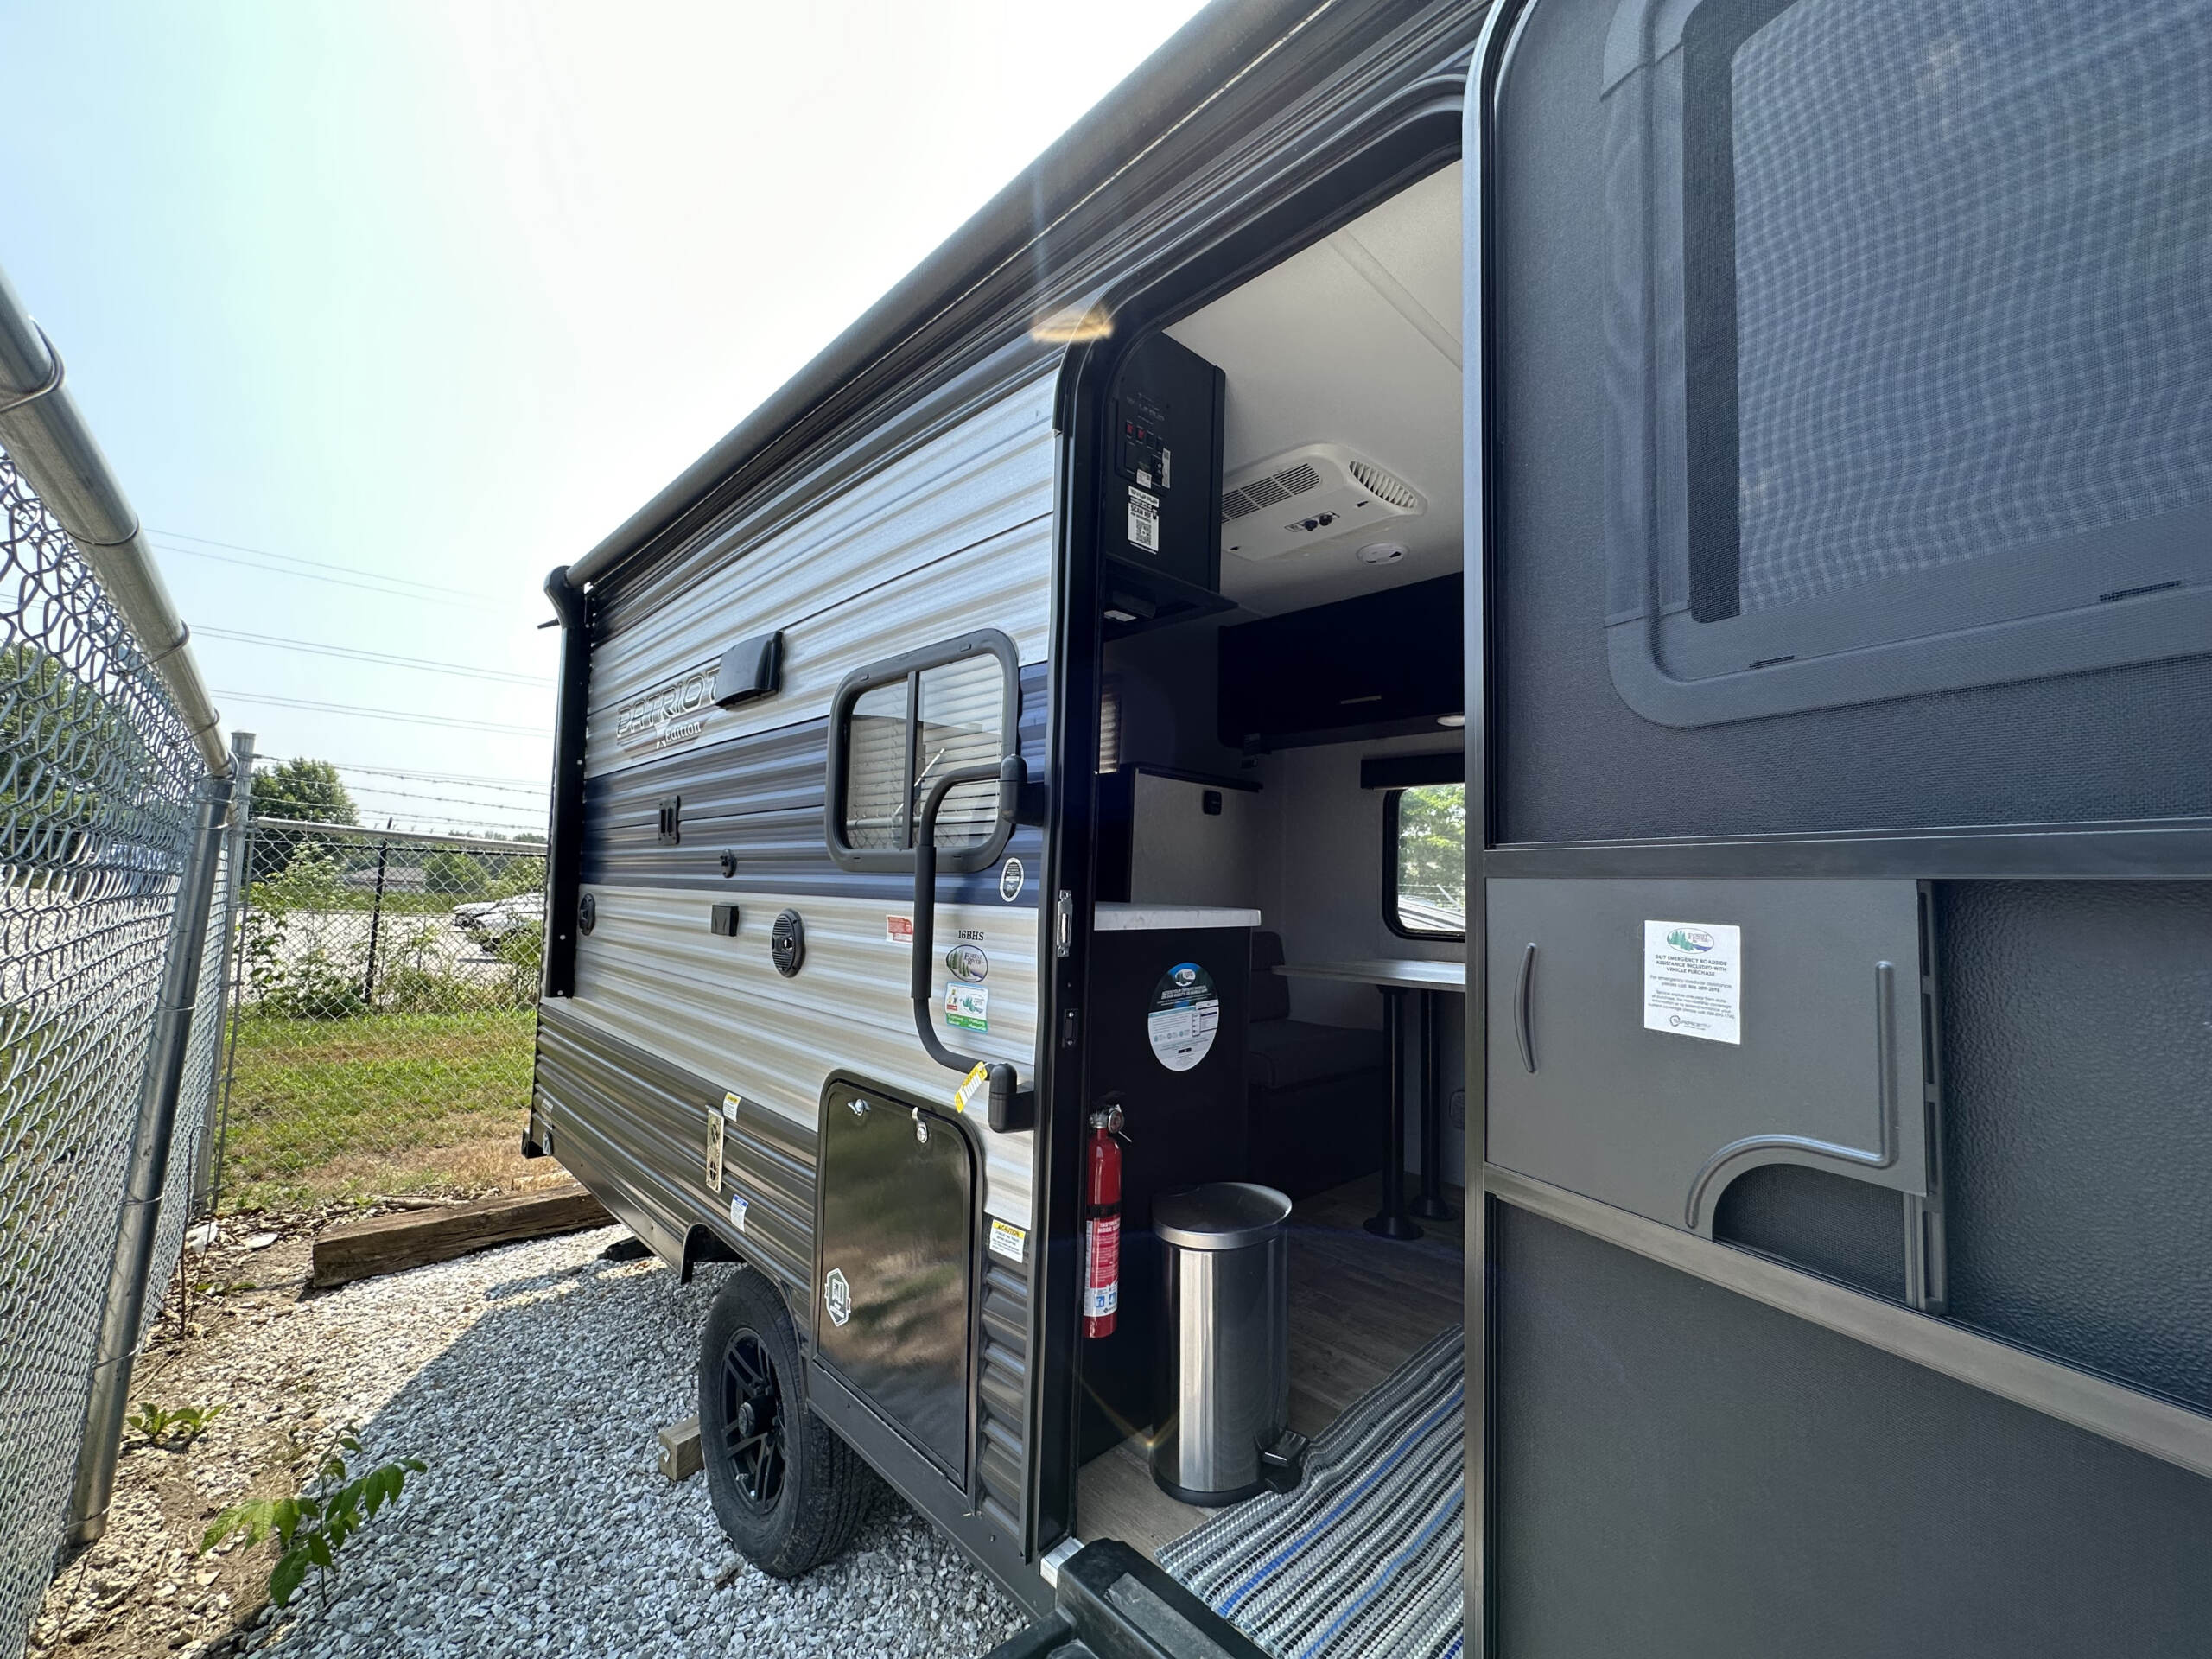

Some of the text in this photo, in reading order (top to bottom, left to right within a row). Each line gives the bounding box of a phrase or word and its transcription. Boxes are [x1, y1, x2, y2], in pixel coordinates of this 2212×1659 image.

[665, 721, 701, 742] Edition
[958, 930, 984, 940] 16BHS
[1667, 955, 1699, 963] EMERGENCY
